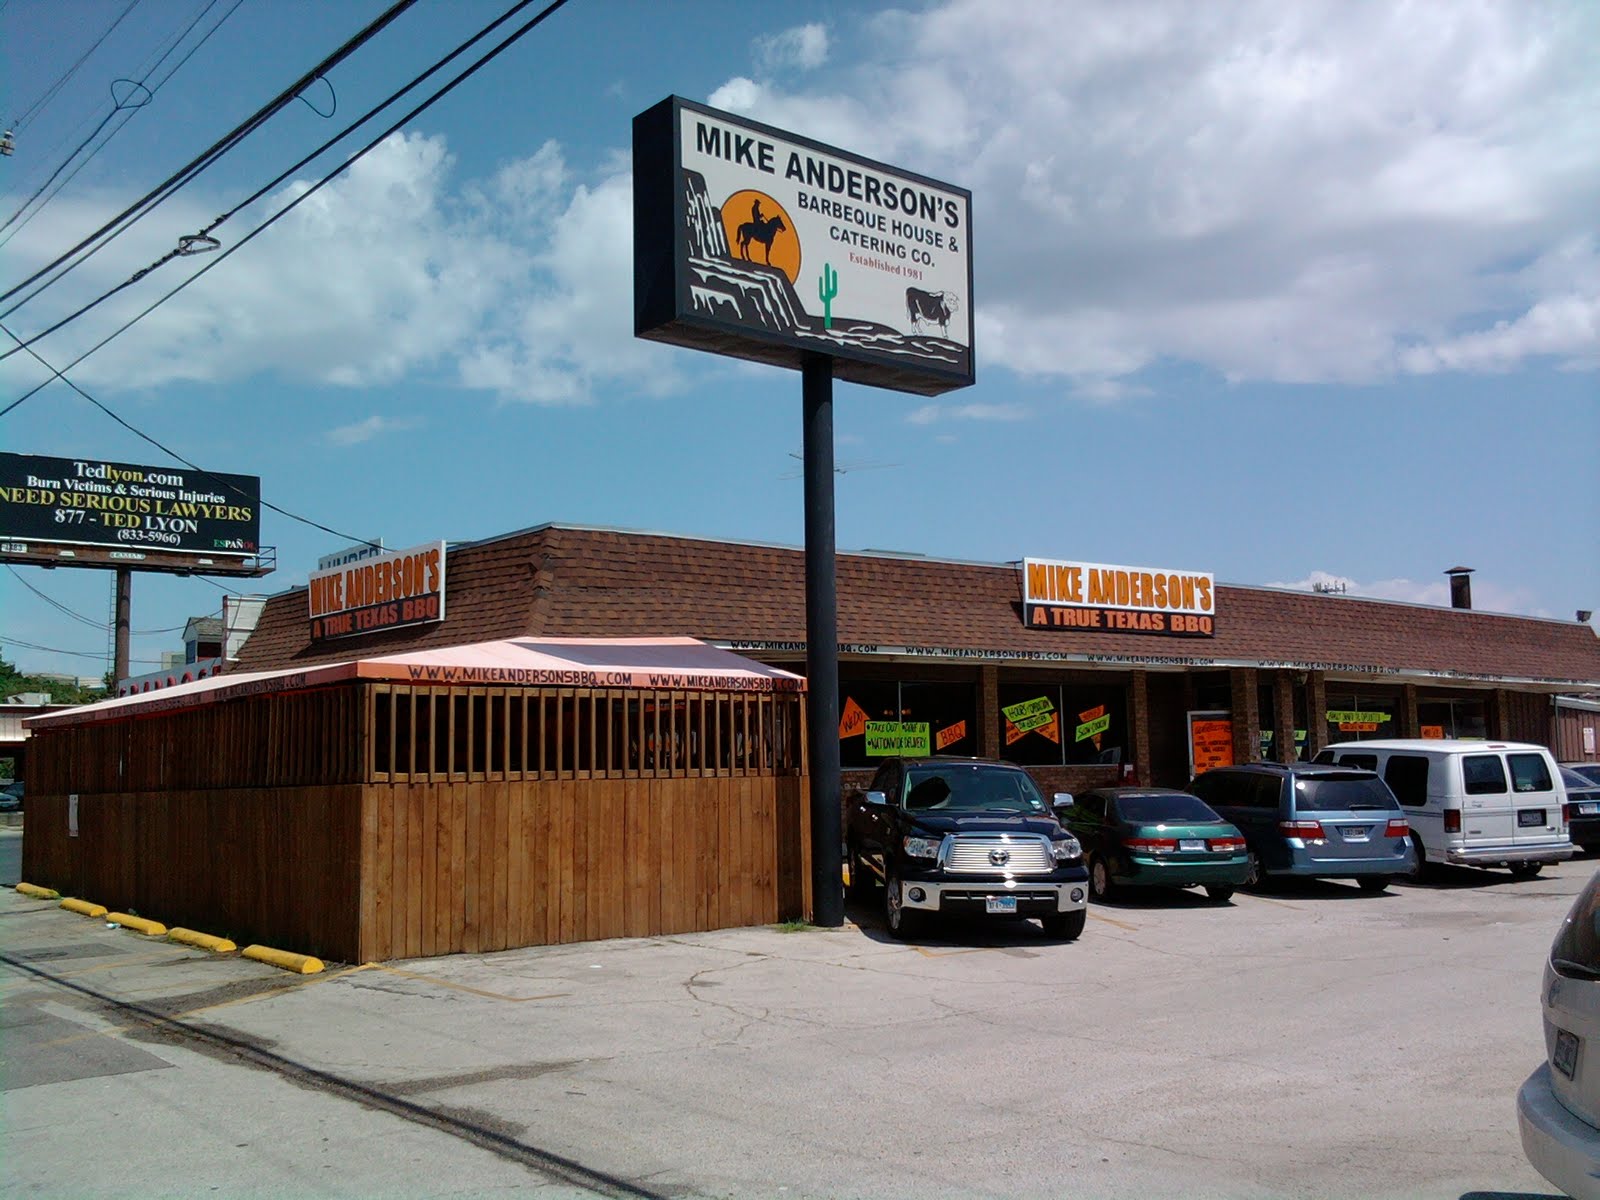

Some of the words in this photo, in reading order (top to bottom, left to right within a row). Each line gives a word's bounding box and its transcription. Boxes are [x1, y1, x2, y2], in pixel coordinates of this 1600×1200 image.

[696, 121, 775, 174] MIKE
[785, 152, 960, 228] ANDERSON'S
[797, 191, 887, 231] BARBEQUE
[891, 219, 943, 248] HOUSE
[948, 236, 959, 252] &
[829, 225, 907, 258] CATERING
[911, 248, 935, 267] CO.
[849, 252, 900, 275] Established
[902, 266, 923, 280] 1981
[73, 461, 183, 487] Tedlyon.com
[27, 475, 61, 489] Burn
[64, 478, 112, 494] Victims
[114, 483, 127, 495] &
[130, 484, 176, 500] Serious
[178, 489, 226, 504] Injuries
[0, 487, 55, 506] NEED
[60, 491, 150, 515] SERIOUS
[156, 500, 252, 522] LAWYERS
[55, 508, 86, 525] 877
[100, 511, 141, 529] TED
[145, 515, 199, 534] LYON
[117, 528, 181, 546] (833-5966)
[310, 572, 342, 616] MIKE
[345, 549, 439, 609] ANDERSON'S
[1027, 563, 1083, 602] MIKE
[1088, 568, 1212, 611] ANDERSON'S
[313, 620, 321, 638] A
[324, 613, 353, 636] TRUE
[356, 603, 398, 630] TEXAS
[402, 596, 437, 621] BBQ
[1033, 607, 1048, 625] A
[1051, 608, 1101, 627] TRUE
[1104, 610, 1165, 631] TEXAS
[1170, 615, 1212, 634] BBQ
[408, 665, 632, 687] WWW.MIKEANDERSONSBBQ.COM
[941, 725, 964, 745] BBQ
